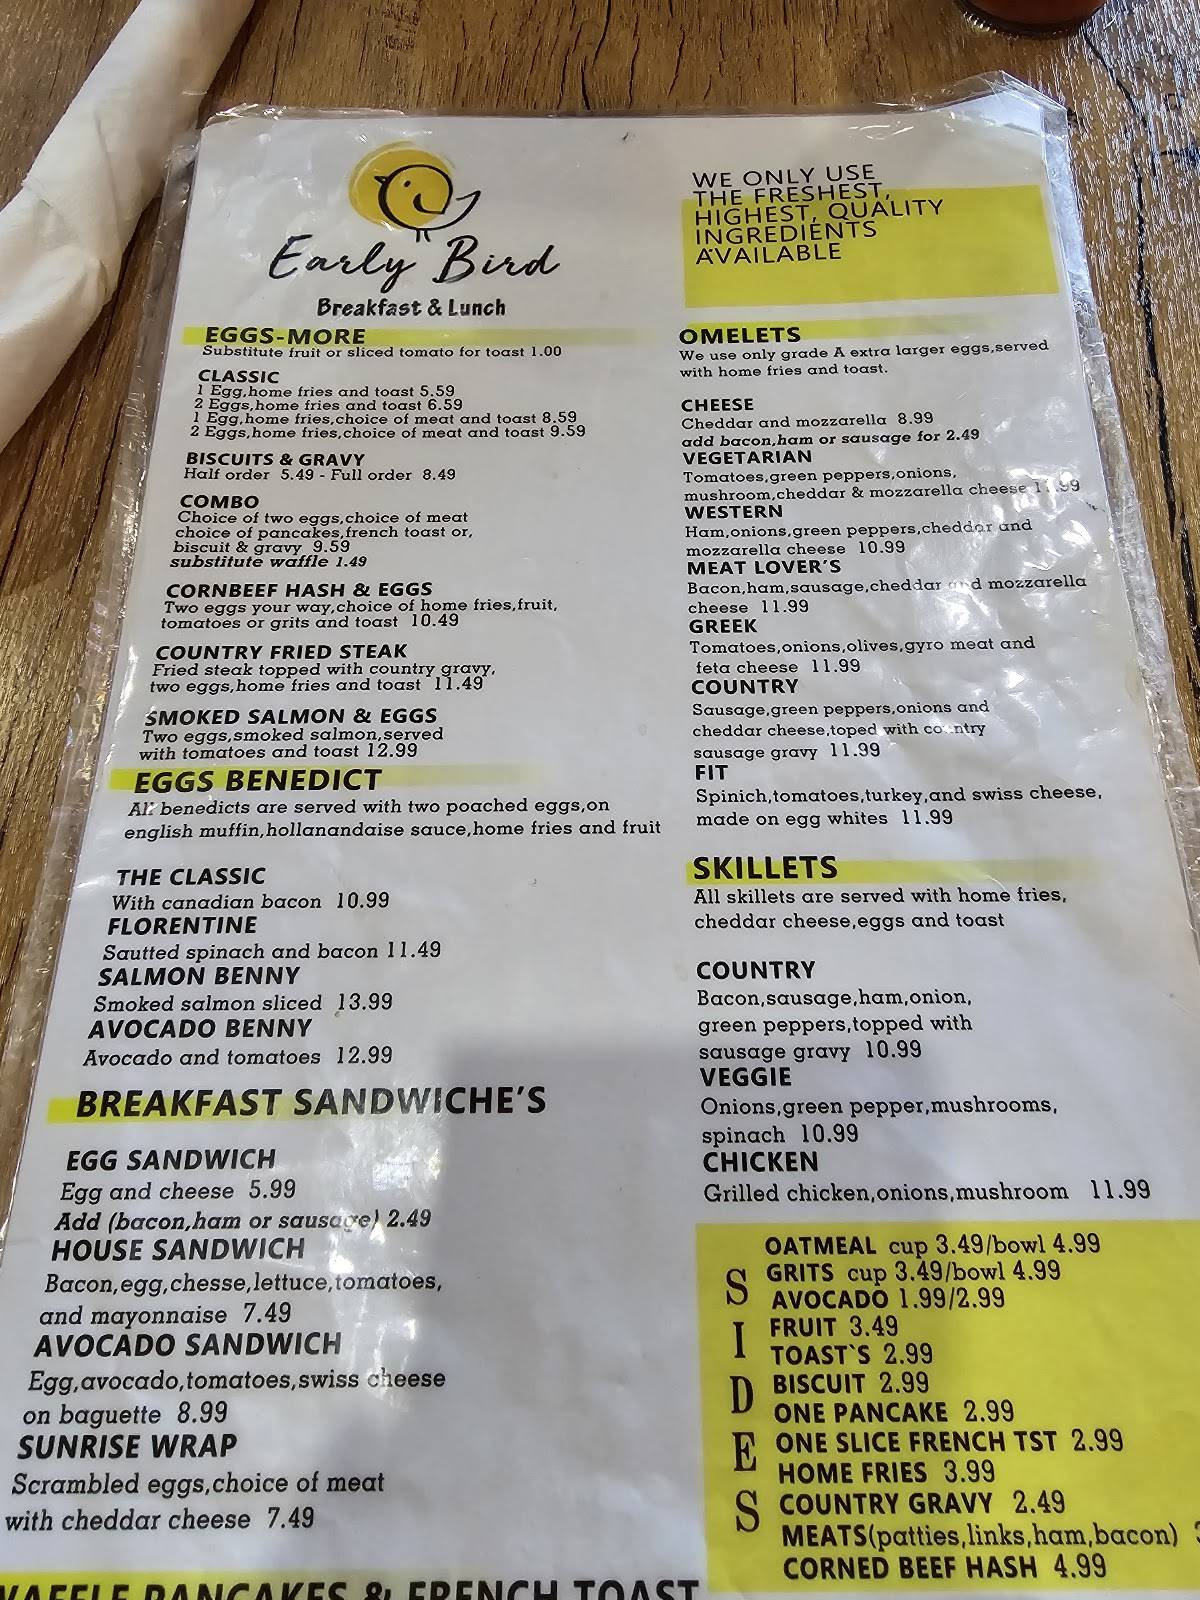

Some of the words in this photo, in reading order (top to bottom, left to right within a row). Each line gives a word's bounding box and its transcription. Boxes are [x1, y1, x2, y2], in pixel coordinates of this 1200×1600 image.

[691, 171, 733, 189] WE
[742, 167, 815, 187] ONLY
[825, 163, 876, 183] USE
[692, 189, 743, 208] THE
[754, 181, 891, 205] FRESHEST,
[695, 203, 817, 227] HIGHEST,
[827, 198, 944, 221] QUALITY
[695, 219, 877, 245] INGREDIENTS
[695, 241, 843, 265] AVAILABLE
[268, 233, 417, 294] Early
[431, 234, 560, 284] Bird
[316, 297, 423, 317] Breakfast
[427, 297, 443, 317] &
[447, 297, 507, 317] Lunch
[205, 326, 367, 346] EGGS-MORE
[678, 326, 801, 345] OMELETS
[201, 344, 284, 358] Substitute
[288, 346, 321, 359] fruit
[325, 349, 343, 358] or
[346, 345, 394, 358] sliced
[399, 347, 455, 358] tomato
[459, 345, 481, 358] for
[485, 347, 525, 358] toast
[531, 345, 562, 357] 1.00
[678, 349, 705, 361] We
[709, 351, 737, 361] use
[741, 348, 777, 363] only
[780, 347, 829, 362] grade
[833, 346, 846, 358] A
[849, 347, 891, 358] extra
[895, 344, 946, 358] larger
[950, 339, 1050, 357] eggs,served
[197, 368, 281, 385] CLASSIC
[679, 365, 713, 379] with
[717, 365, 762, 378] home
[766, 364, 803, 377] fries
[807, 363, 839, 376] and
[843, 363, 889, 375] toast.
[197, 383, 203, 396] 1
[209, 383, 293, 400] Egg,home
[297, 385, 333, 398] fries
[337, 385, 369, 398] and
[373, 386, 415, 398] toast
[419, 384, 455, 398] 5.59
[680, 397, 755, 413] CHEESE
[681, 417, 754, 430] Cheddar
[758, 415, 791, 429] and
[795, 413, 887, 428] mozzarella
[897, 411, 934, 425] 8.99
[185, 451, 275, 467] BISCUITS
[279, 452, 294, 467] &
[297, 453, 366, 467] GRAVY
[682, 449, 813, 466] VEGETARIAN
[183, 466, 221, 480] Half
[224, 467, 271, 481] order
[280, 467, 315, 481] 5.49
[330, 467, 363, 481] Full
[367, 468, 413, 481] order
[422, 467, 456, 481] 8.49
[179, 493, 260, 509] COMBO
[683, 504, 783, 520] WESTERN
[685, 543, 782, 557] mozzarella
[786, 542, 847, 556] cheese
[858, 539, 906, 555] 10.99
[687, 560, 747, 576] MEAT
[165, 583, 279, 599] CORNBEEF
[285, 583, 346, 598] HASH
[352, 582, 371, 598] &
[377, 581, 433, 597] EGGS
[688, 618, 759, 635] GREEK
[155, 645, 264, 661] COUNTRY
[269, 644, 333, 661] FRIED
[339, 643, 408, 660] STEAK
[695, 660, 731, 675] feta
[736, 659, 799, 675] cheese
[811, 657, 861, 673] 11.99
[144, 709, 241, 727] SMOKED
[247, 707, 345, 725] SALMON
[352, 707, 373, 725] &
[379, 707, 437, 724] EGGS
[138, 745, 177, 761] with
[181, 745, 267, 760] tomatoes
[271, 743, 308, 759] and
[313, 744, 360, 758] toast
[367, 741, 418, 758] 12.99
[133, 769, 215, 795] EGGS
[225, 768, 383, 792] BENEDICT
[695, 764, 729, 781] FIT
[695, 811, 750, 827] made
[755, 815, 781, 827] on
[785, 814, 821, 829] egg
[826, 809, 889, 825] whites
[901, 808, 953, 825] 11.99
[116, 868, 163, 887] THE
[169, 867, 267, 887] CLASSIC
[693, 855, 838, 881] SKILLETS
[111, 894, 155, 911] With
[161, 893, 255, 911] canadian
[259, 893, 323, 909] bacon
[336, 891, 390, 909] 10.99
[693, 888, 721, 905] All
[726, 887, 796, 905] skillets
[801, 892, 835, 904] are
[840, 887, 905, 904] served
[909, 886, 953, 903] with
[956, 886, 1011, 903] home
[1016, 886, 1067, 904] fries,
[97, 966, 206, 987] SALMON
[213, 965, 301, 985] BENNY
[93, 994, 175, 1013] Smoked
[179, 994, 256, 1013] salmon
[261, 993, 323, 1011] sliced
[337, 992, 393, 1011] 13.99
[699, 1046, 787, 1064] sausage
[792, 1046, 851, 1063] gravy
[865, 1039, 922, 1059] 10.99
[699, 1066, 793, 1087] VEGGIE
[75, 1088, 283, 1119] BREAKFAST
[701, 1124, 786, 1149] spinach
[801, 1122, 859, 1143] 10.99
[702, 1150, 819, 1173] CHICKEN
[59, 1181, 103, 1206] Egg
[109, 1181, 153, 1201] and
[159, 1181, 235, 1201] cheese
[248, 1178, 297, 1199] 5.99
[765, 1235, 877, 1256] OATMEAL
[888, 1240, 929, 1260] cup
[935, 1233, 1047, 1257] 3.49/bowl
[1052, 1232, 1101, 1254] 4.99
[39, 1304, 83, 1326] and
[89, 1305, 228, 1331] mayonnaise
[243, 1301, 292, 1324] 7.49
[32, 1333, 176, 1359] AVOCADO
[184, 1331, 342, 1357] SANDWICH
[883, 1341, 933, 1365] 2.99
[22, 1409, 51, 1425] on
[58, 1403, 162, 1430] baguette
[177, 1399, 228, 1425] 8.99
[16, 1433, 141, 1461] SUNRISE
[151, 1433, 238, 1459] WRAP
[779, 1492, 899, 1517] COUNTRY
[908, 1491, 993, 1515] GRAVY
[1012, 1489, 1066, 1515] 2.49
[783, 1555, 890, 1581] CORNED
[898, 1555, 957, 1580] BEEF
[965, 1555, 1038, 1579] HASH
[1053, 1551, 1107, 1579] 4.99
